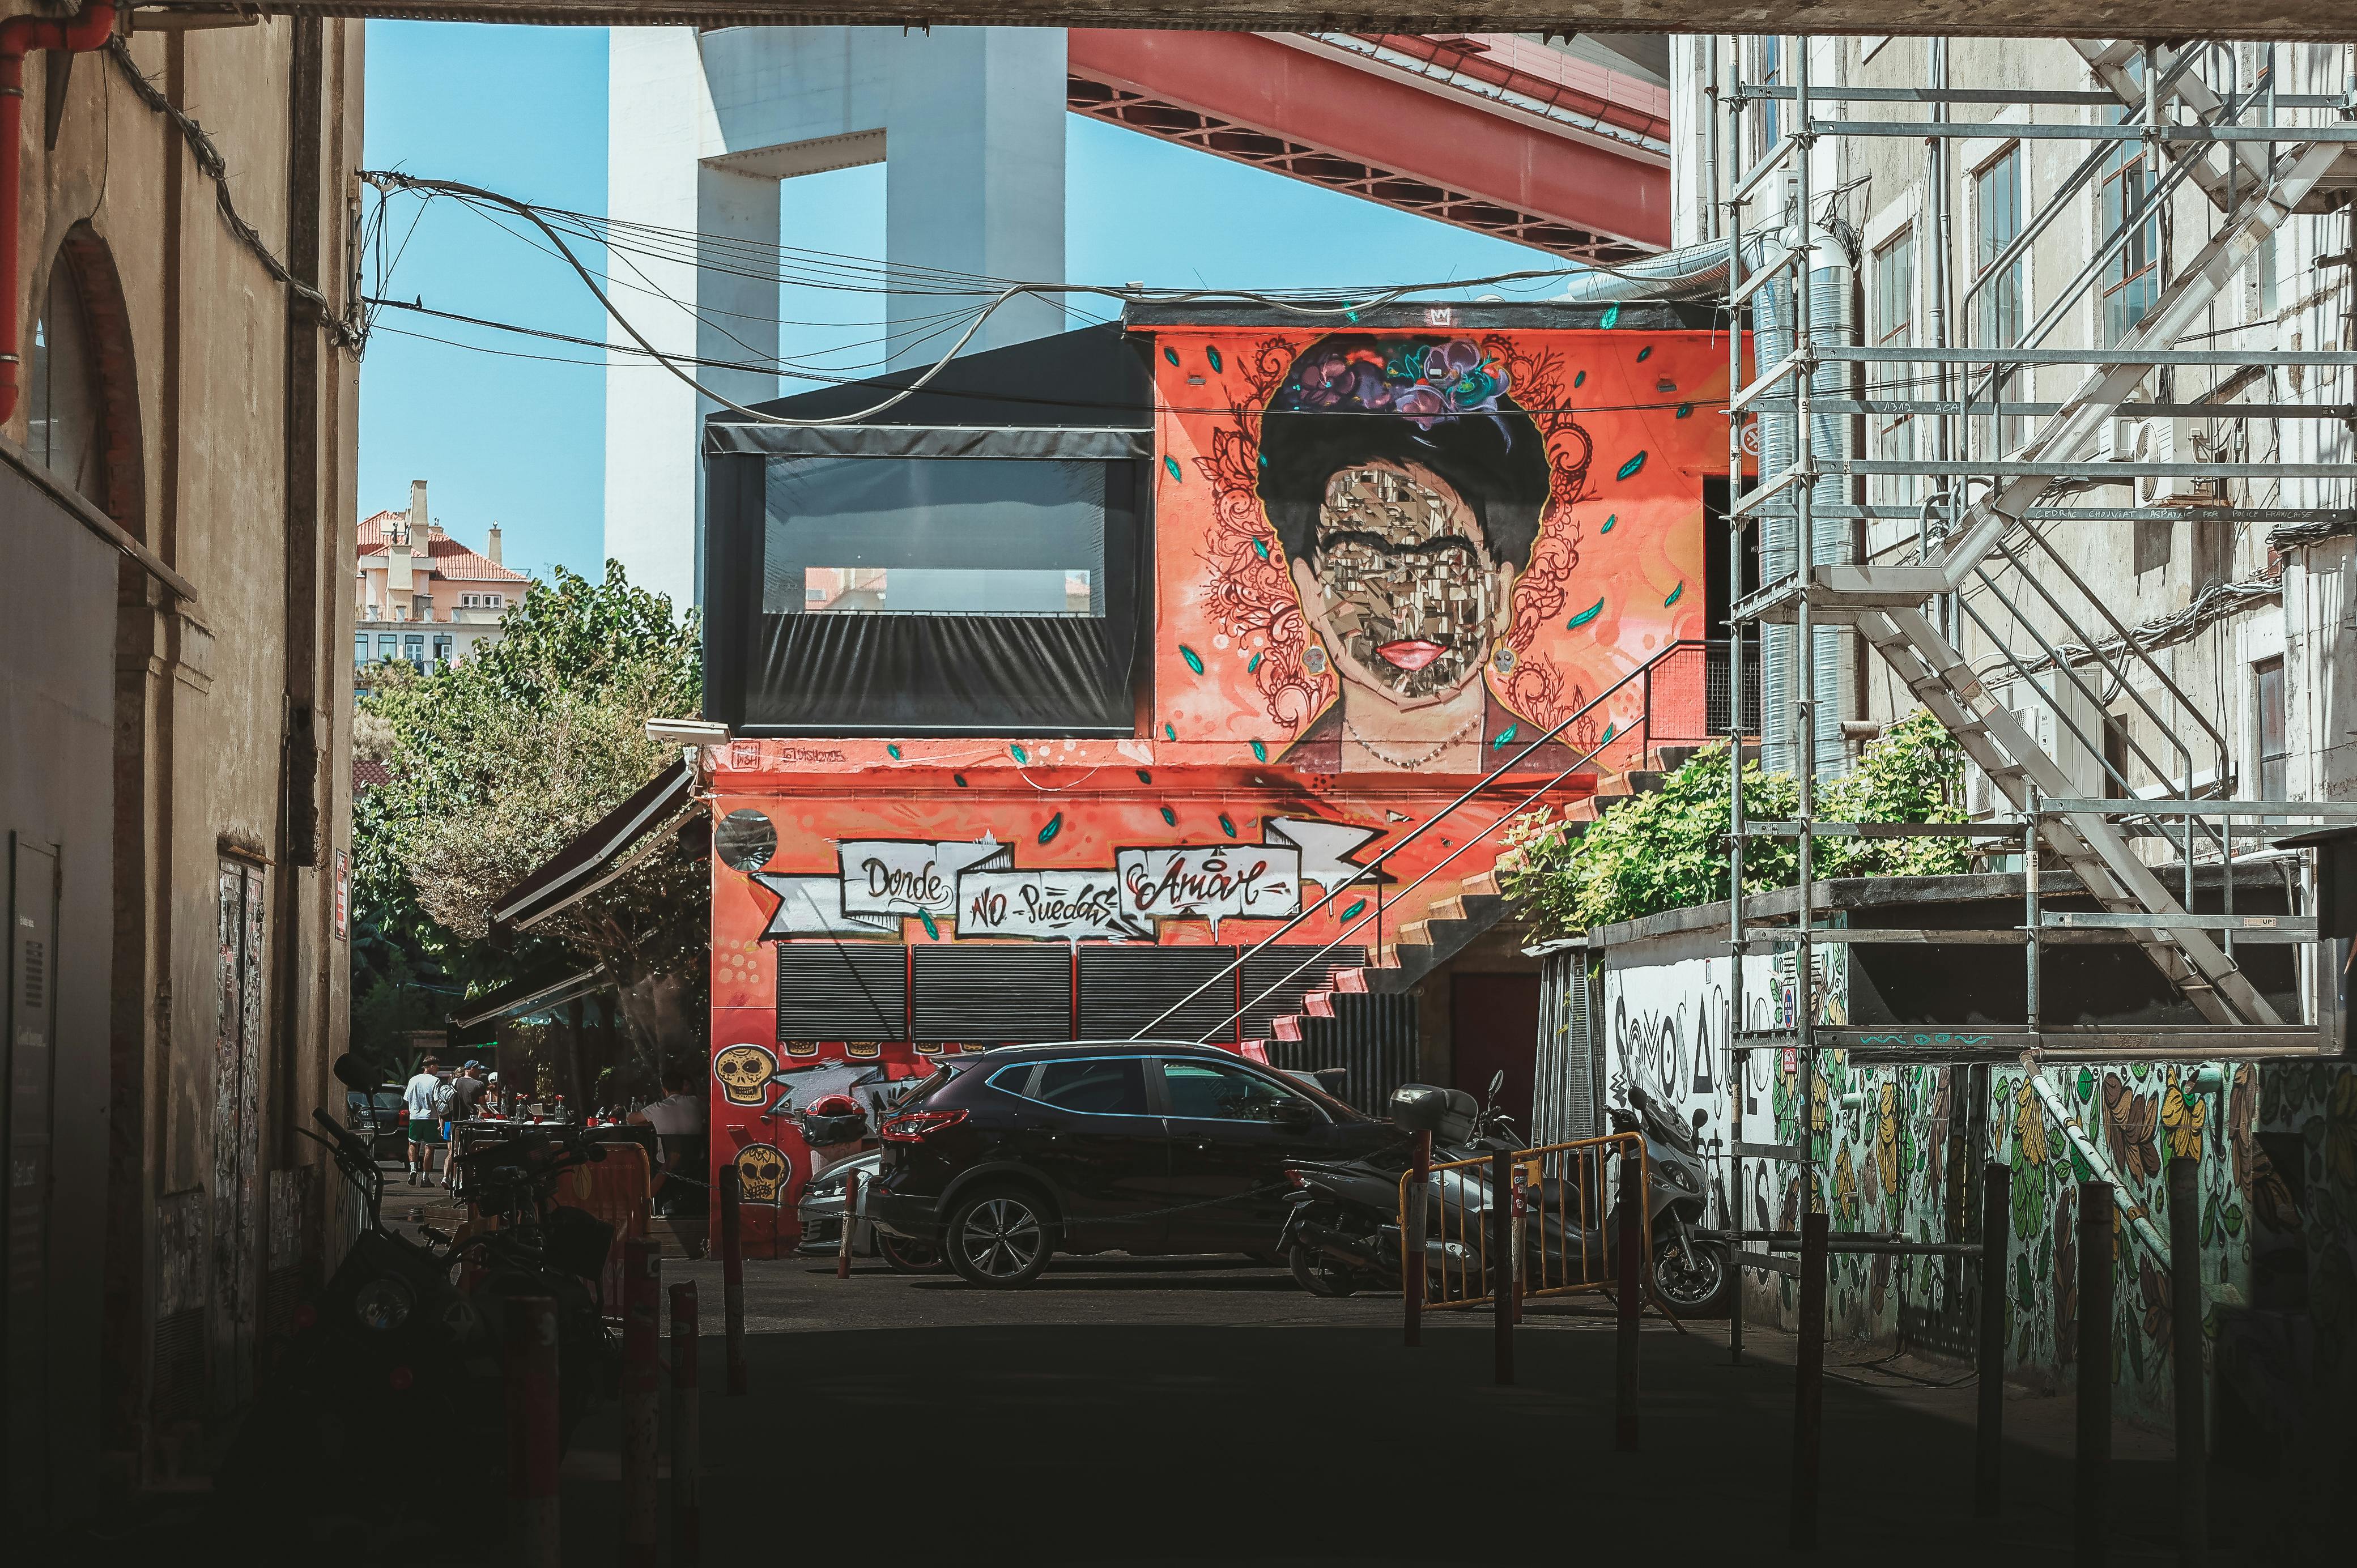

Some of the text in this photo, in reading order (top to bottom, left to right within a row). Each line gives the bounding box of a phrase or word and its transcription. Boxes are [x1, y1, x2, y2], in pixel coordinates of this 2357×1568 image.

[1802, 401, 1808, 414] UP
[1883, 402, 1960, 412] 1312 ACA
[862, 857, 944, 902] Donde
[971, 885, 1007, 928] NO
